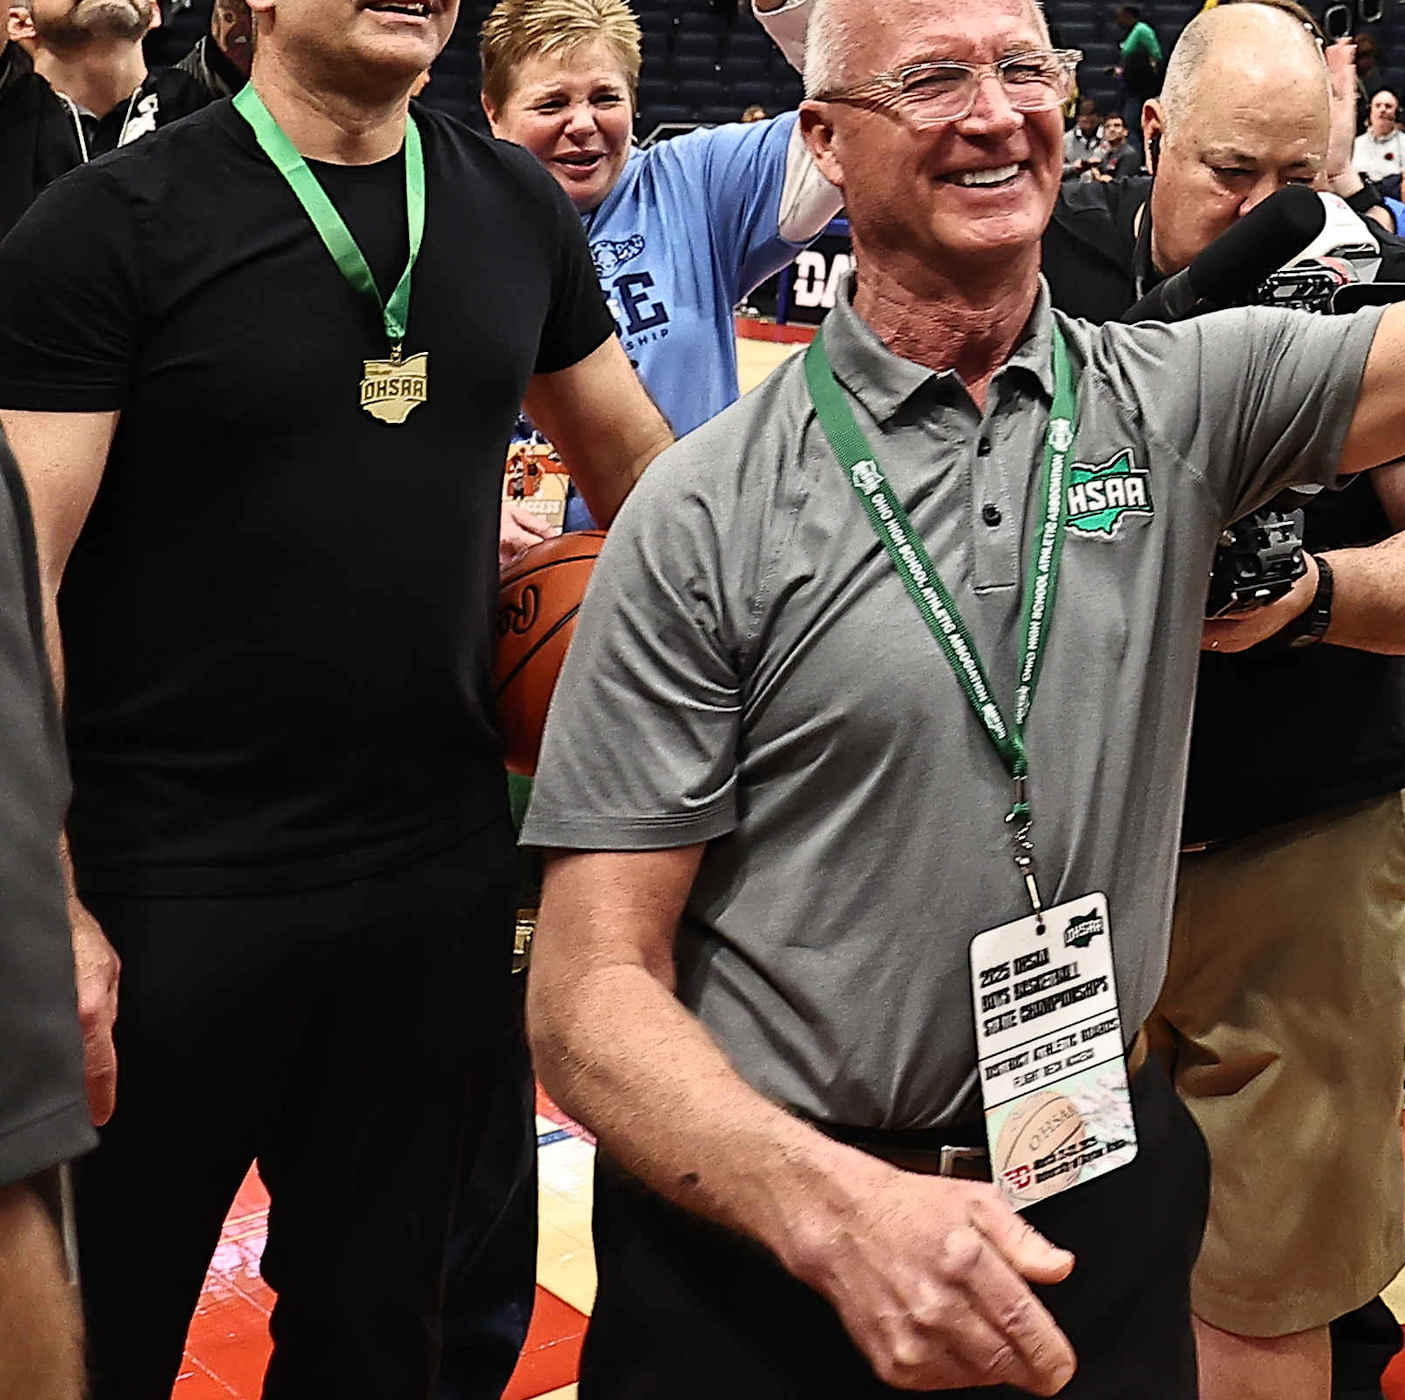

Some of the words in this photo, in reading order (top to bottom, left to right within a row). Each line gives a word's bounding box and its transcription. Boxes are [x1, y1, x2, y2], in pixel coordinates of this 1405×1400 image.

[364, 378, 424, 401] OHSAA
[1067, 477, 1148, 516] HSAA
[871, 492, 893, 521] OHIO
[884, 518, 907, 547] HIGH
[900, 543, 930, 589] SCHOOL
[920, 585, 957, 634] ATHLETIC
[947, 633, 989, 703] ASSOCIATION
